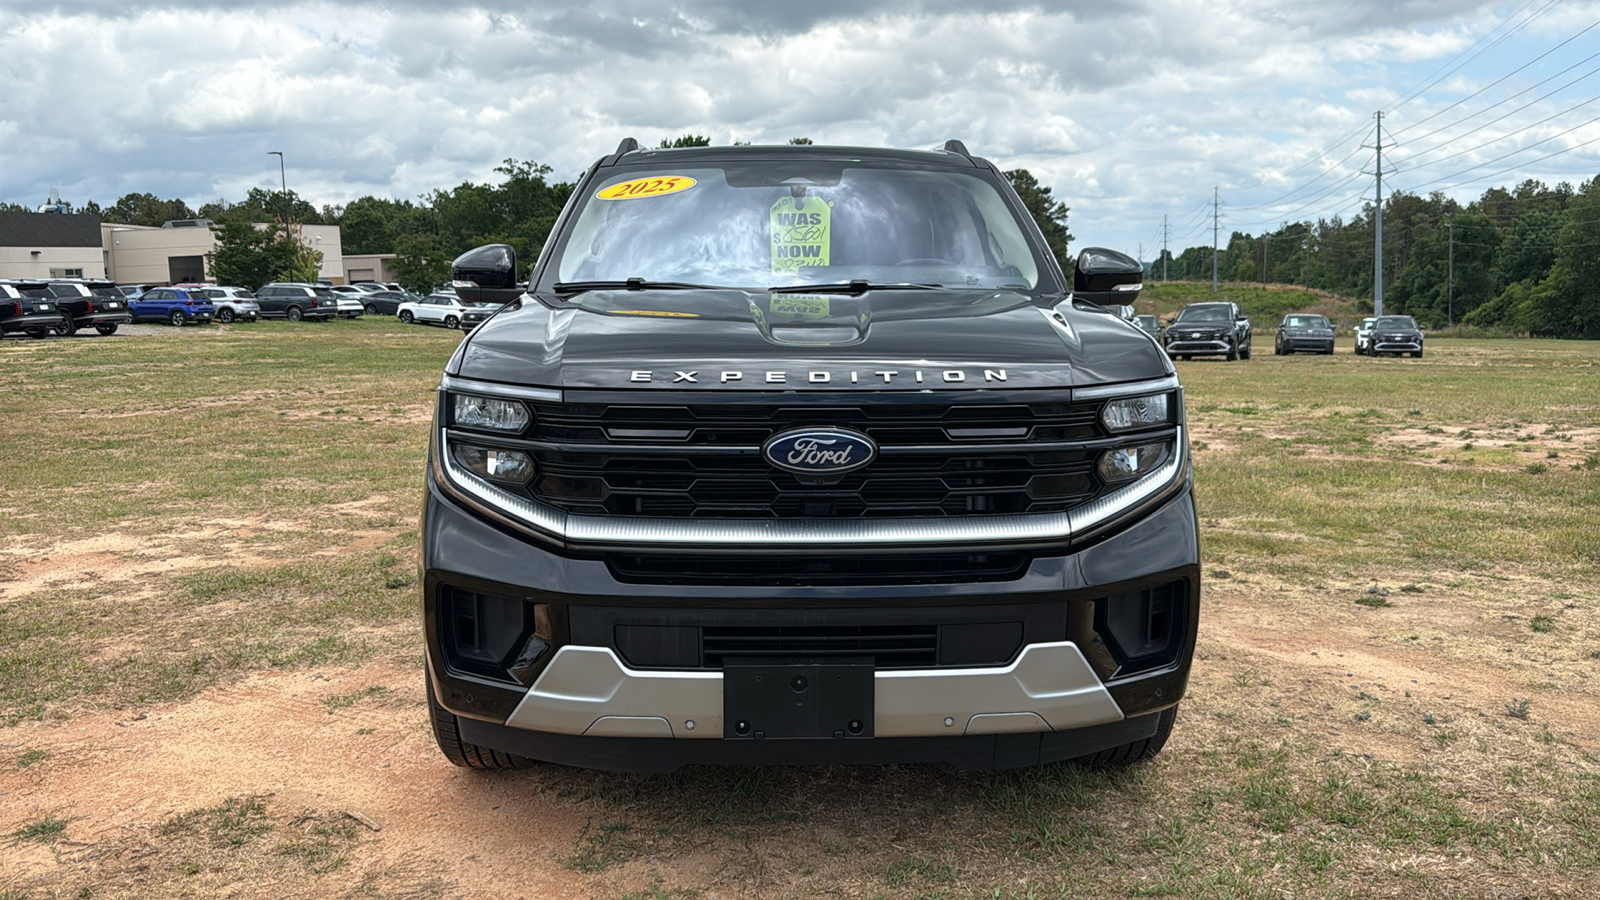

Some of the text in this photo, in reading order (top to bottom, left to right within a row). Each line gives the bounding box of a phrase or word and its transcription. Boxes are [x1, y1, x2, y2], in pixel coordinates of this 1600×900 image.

[611, 178, 681, 198] 2025
[777, 213, 822, 225] WAS
[777, 246, 822, 258] NOW
[630, 369, 1008, 383] EXPEDITION
[787, 437, 853, 464] Ford
